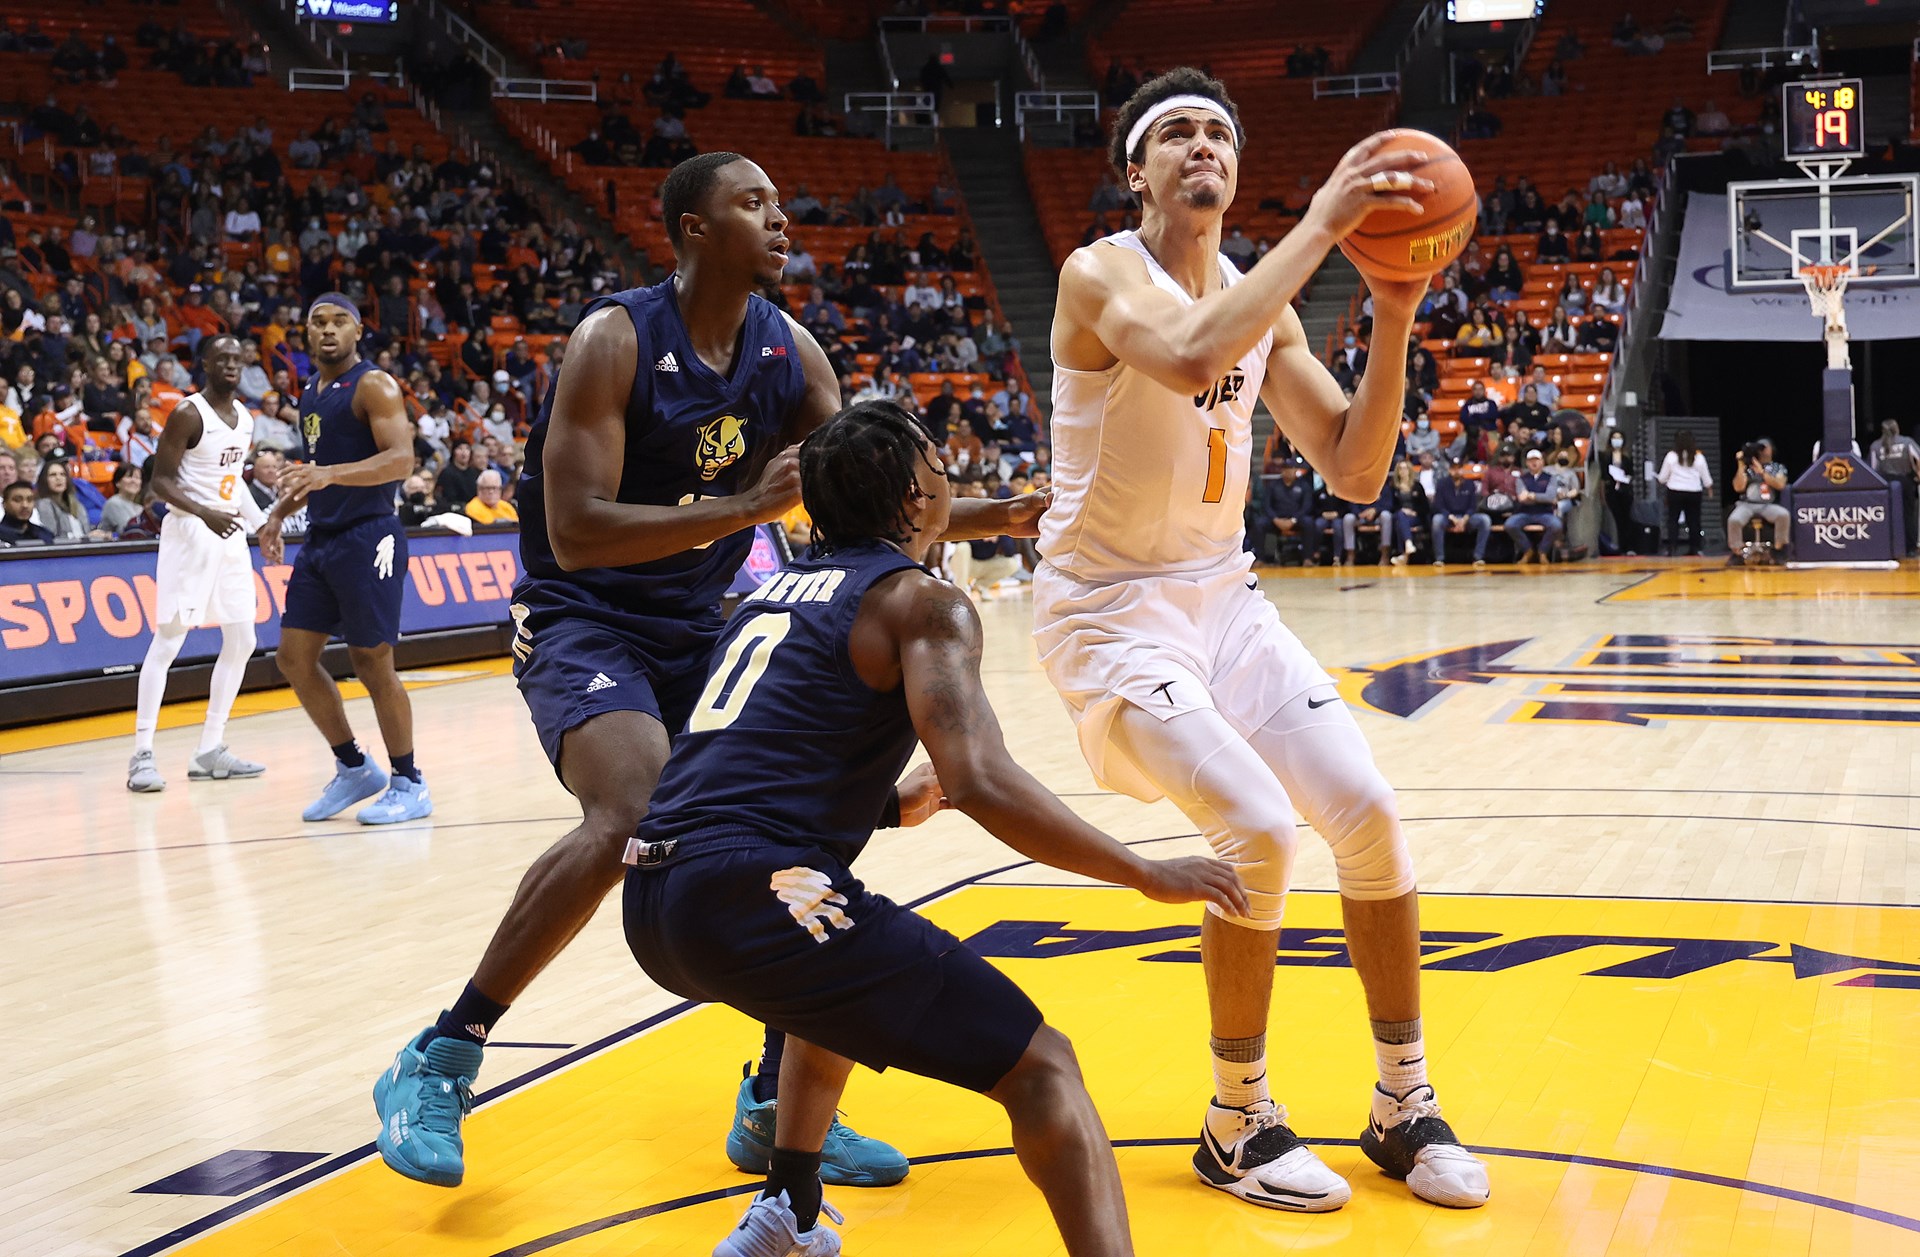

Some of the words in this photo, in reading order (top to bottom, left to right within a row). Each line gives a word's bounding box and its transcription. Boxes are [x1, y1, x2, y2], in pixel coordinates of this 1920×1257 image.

[1805, 87, 1854, 110] 4:18
[1815, 110, 1847, 147] 19
[1201, 427, 1228, 503] 1
[1797, 506, 1885, 524] SPEAKING
[1814, 523, 1871, 549] ROCK
[407, 550, 517, 607] UTEP
[586, 681, 618, 692] adidas
[689, 611, 791, 733] 0
